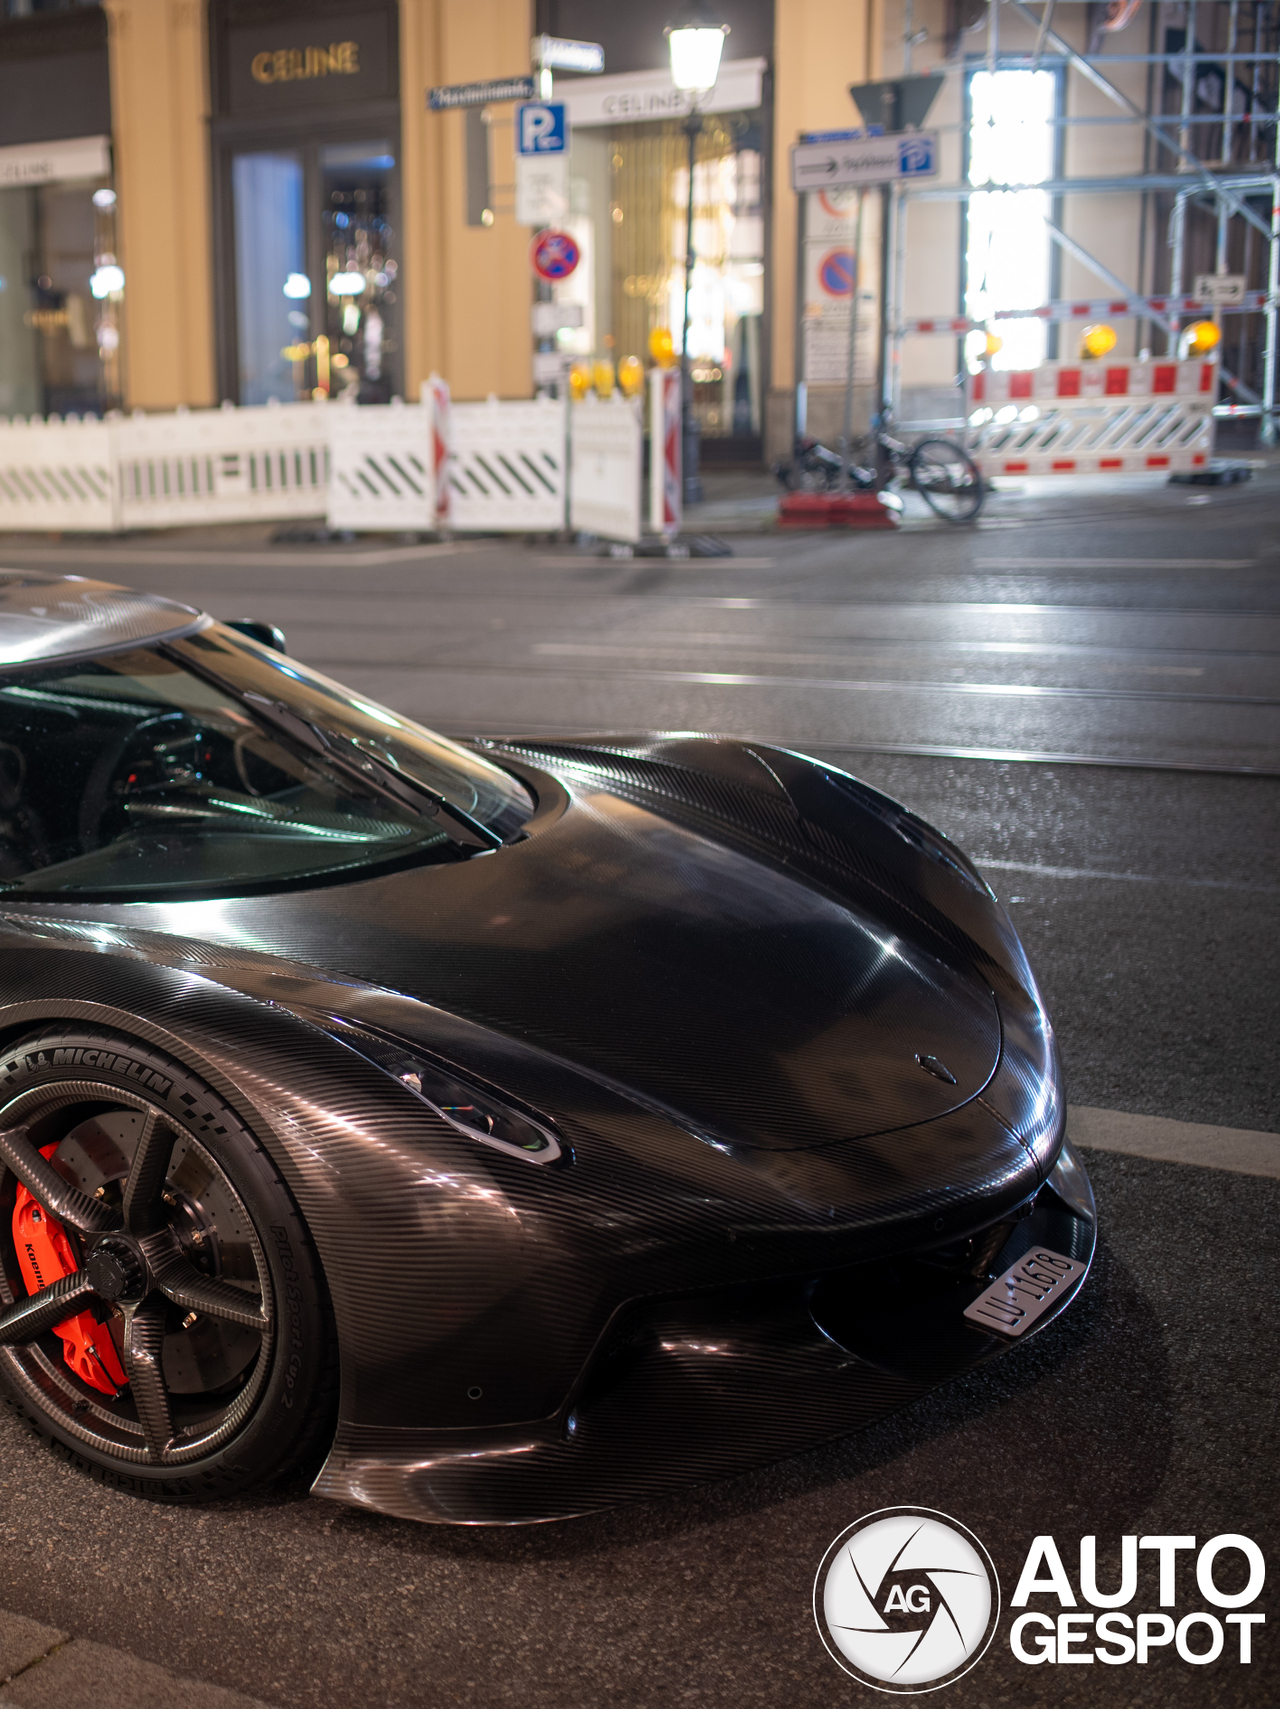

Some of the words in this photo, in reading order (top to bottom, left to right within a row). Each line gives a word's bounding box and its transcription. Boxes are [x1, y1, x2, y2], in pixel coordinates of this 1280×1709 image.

[251, 41, 360, 84] CELINE
[52, 1048, 174, 1094] MICHELIN
[269, 1225, 299, 1281] Pilot
[286, 1282, 304, 1350] Sport
[283, 1352, 302, 1390] Cup
[280, 1391, 294, 1409] 2
